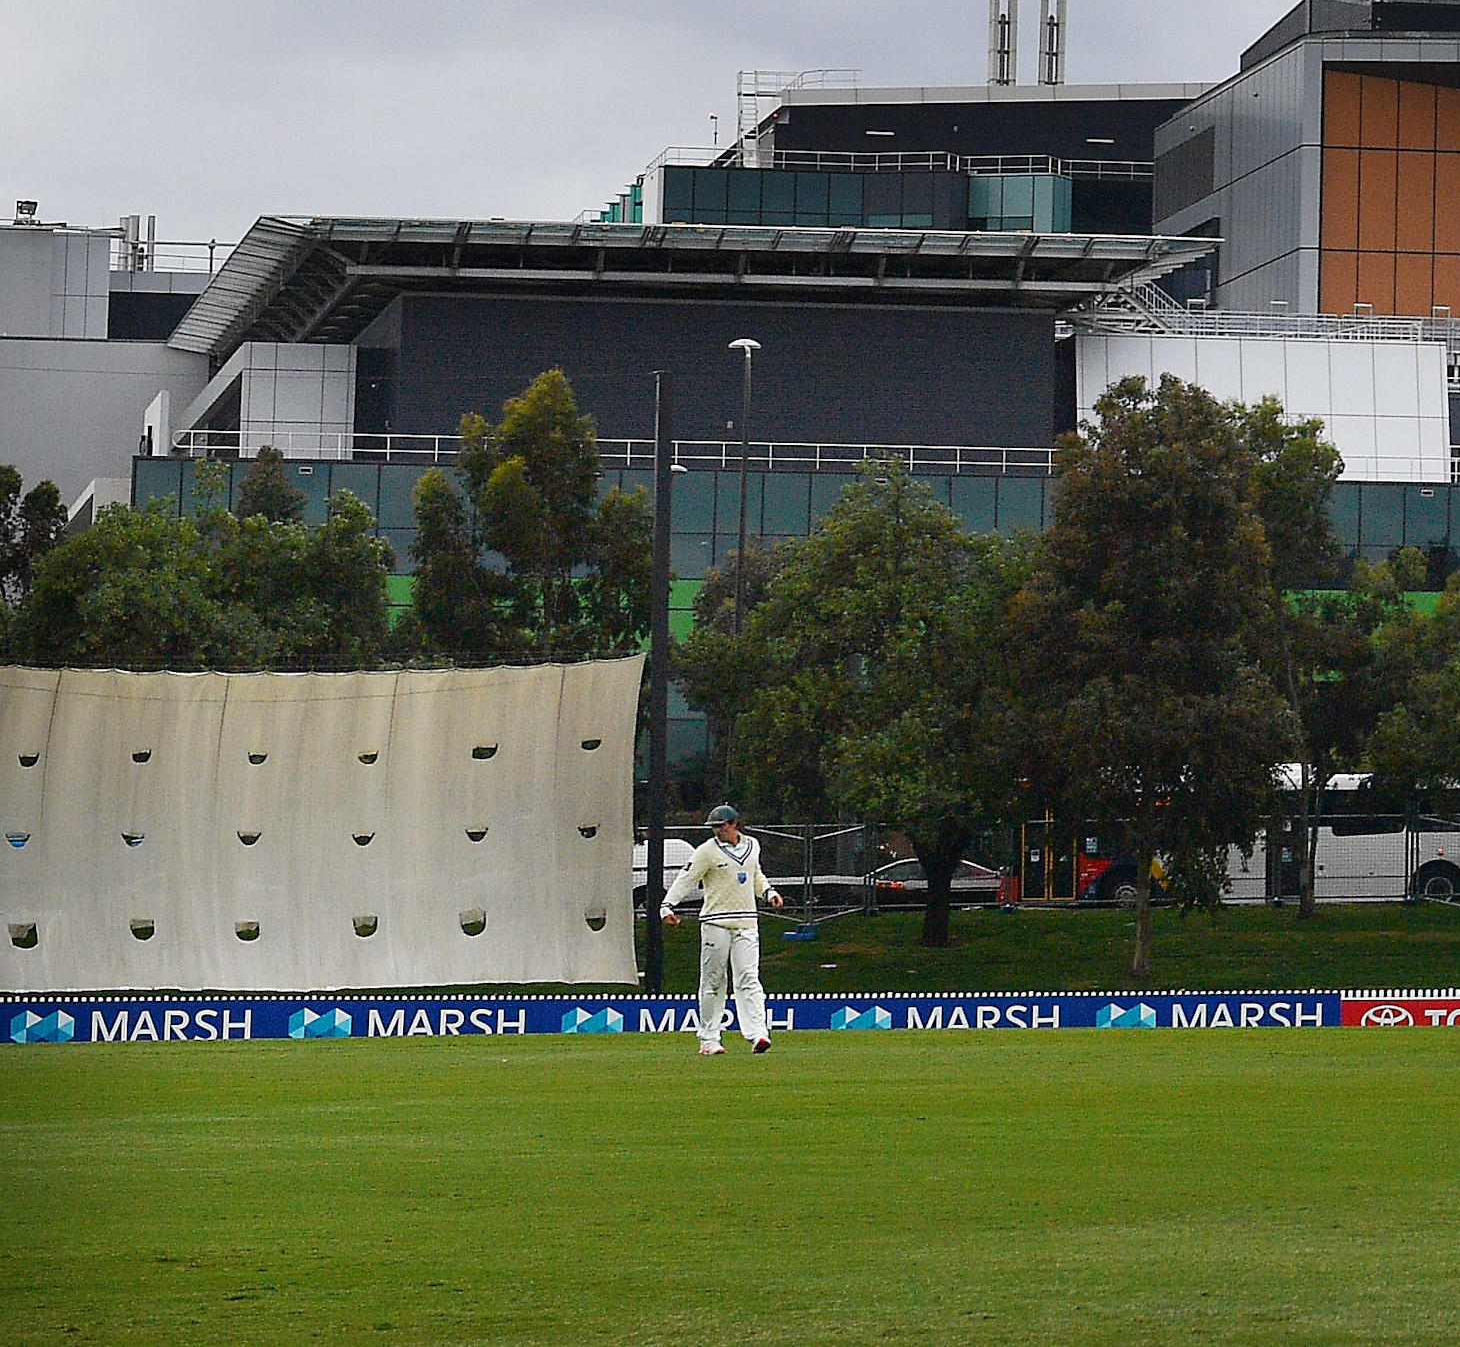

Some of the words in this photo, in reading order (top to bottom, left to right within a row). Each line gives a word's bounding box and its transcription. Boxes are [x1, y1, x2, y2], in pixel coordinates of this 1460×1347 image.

[91, 1009, 251, 1042] MARSH
[367, 1009, 526, 1037] MARSH
[639, 1008, 795, 1033] MARH
[907, 1005, 1060, 1029] MARSH
[1172, 1002, 1323, 1028] MARSH
